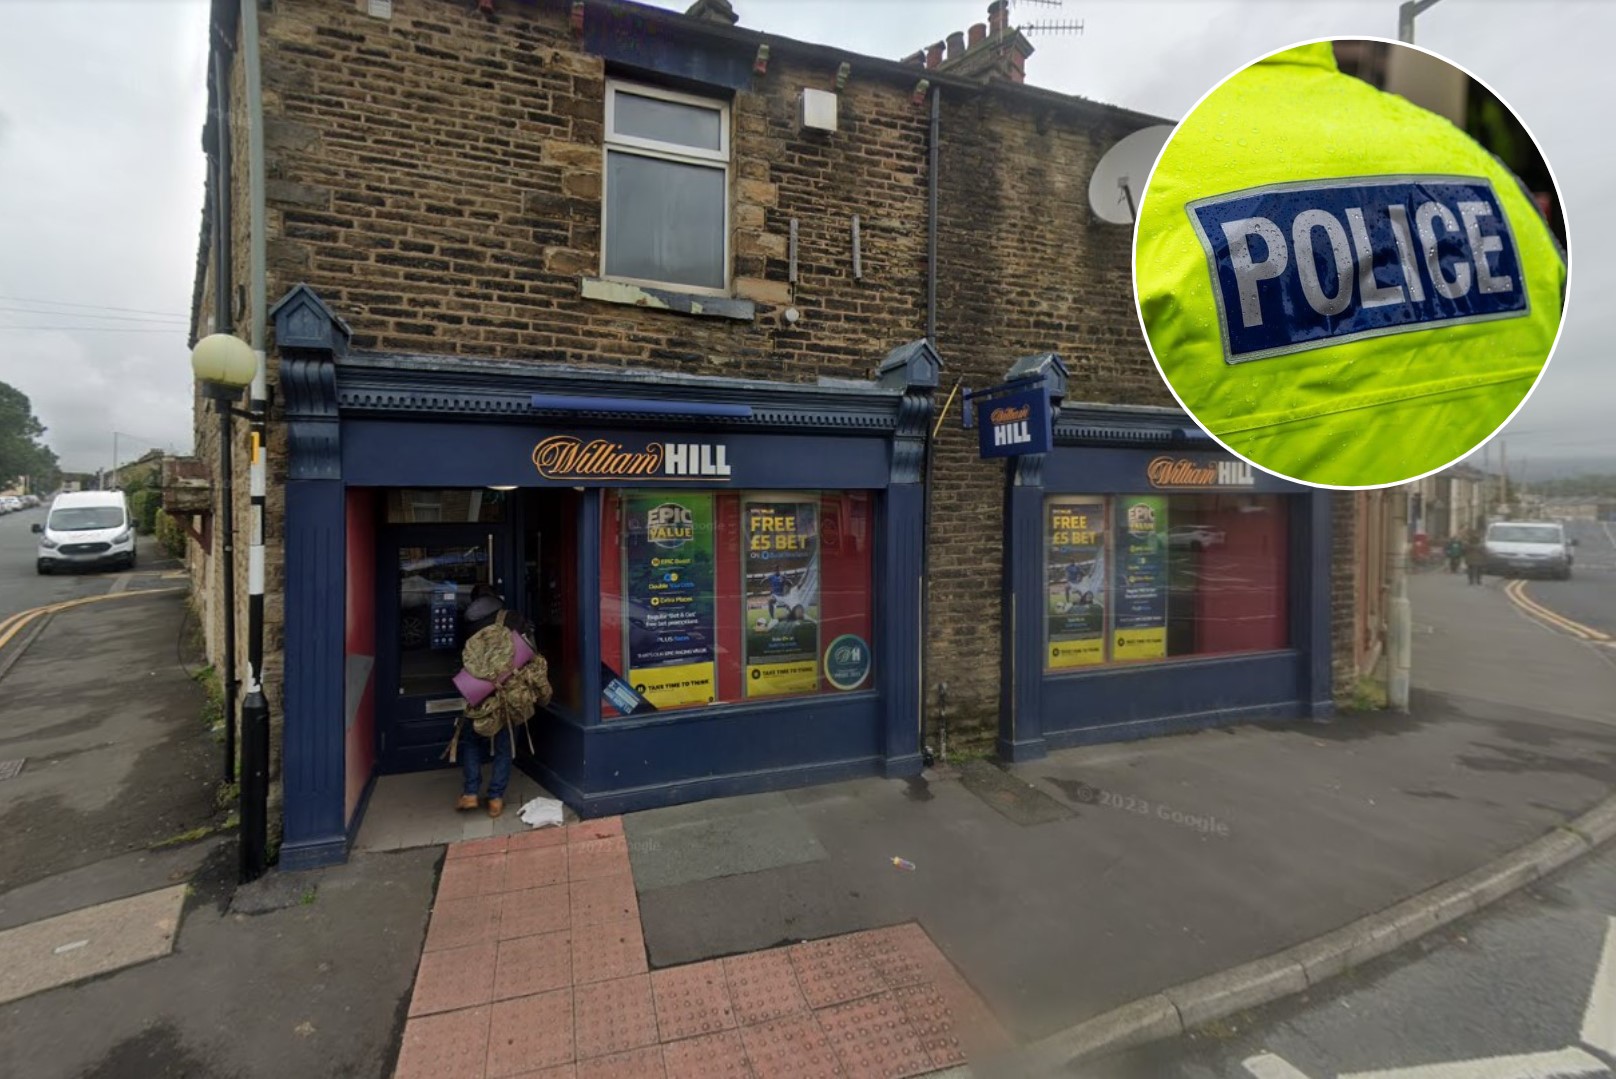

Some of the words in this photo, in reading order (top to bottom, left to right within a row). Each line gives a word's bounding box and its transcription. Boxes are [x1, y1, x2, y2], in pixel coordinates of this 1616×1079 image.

[1220, 200, 1514, 328] POLICE
[991, 404, 1030, 424] William
[994, 421, 1031, 446] HILL
[532, 435, 664, 480] William
[664, 443, 731, 475] HILL
[1148, 456, 1217, 487] William
[1218, 461, 1254, 485] HILL
[648, 507, 693, 524] EPIC
[751, 517, 796, 531] FREE
[1053, 515, 1087, 529] FREE
[649, 527, 693, 539] VALUE
[1053, 532, 1069, 544] £5
[1072, 531, 1096, 544] BET
[751, 534, 771, 550] £5
[775, 534, 807, 550] BET
